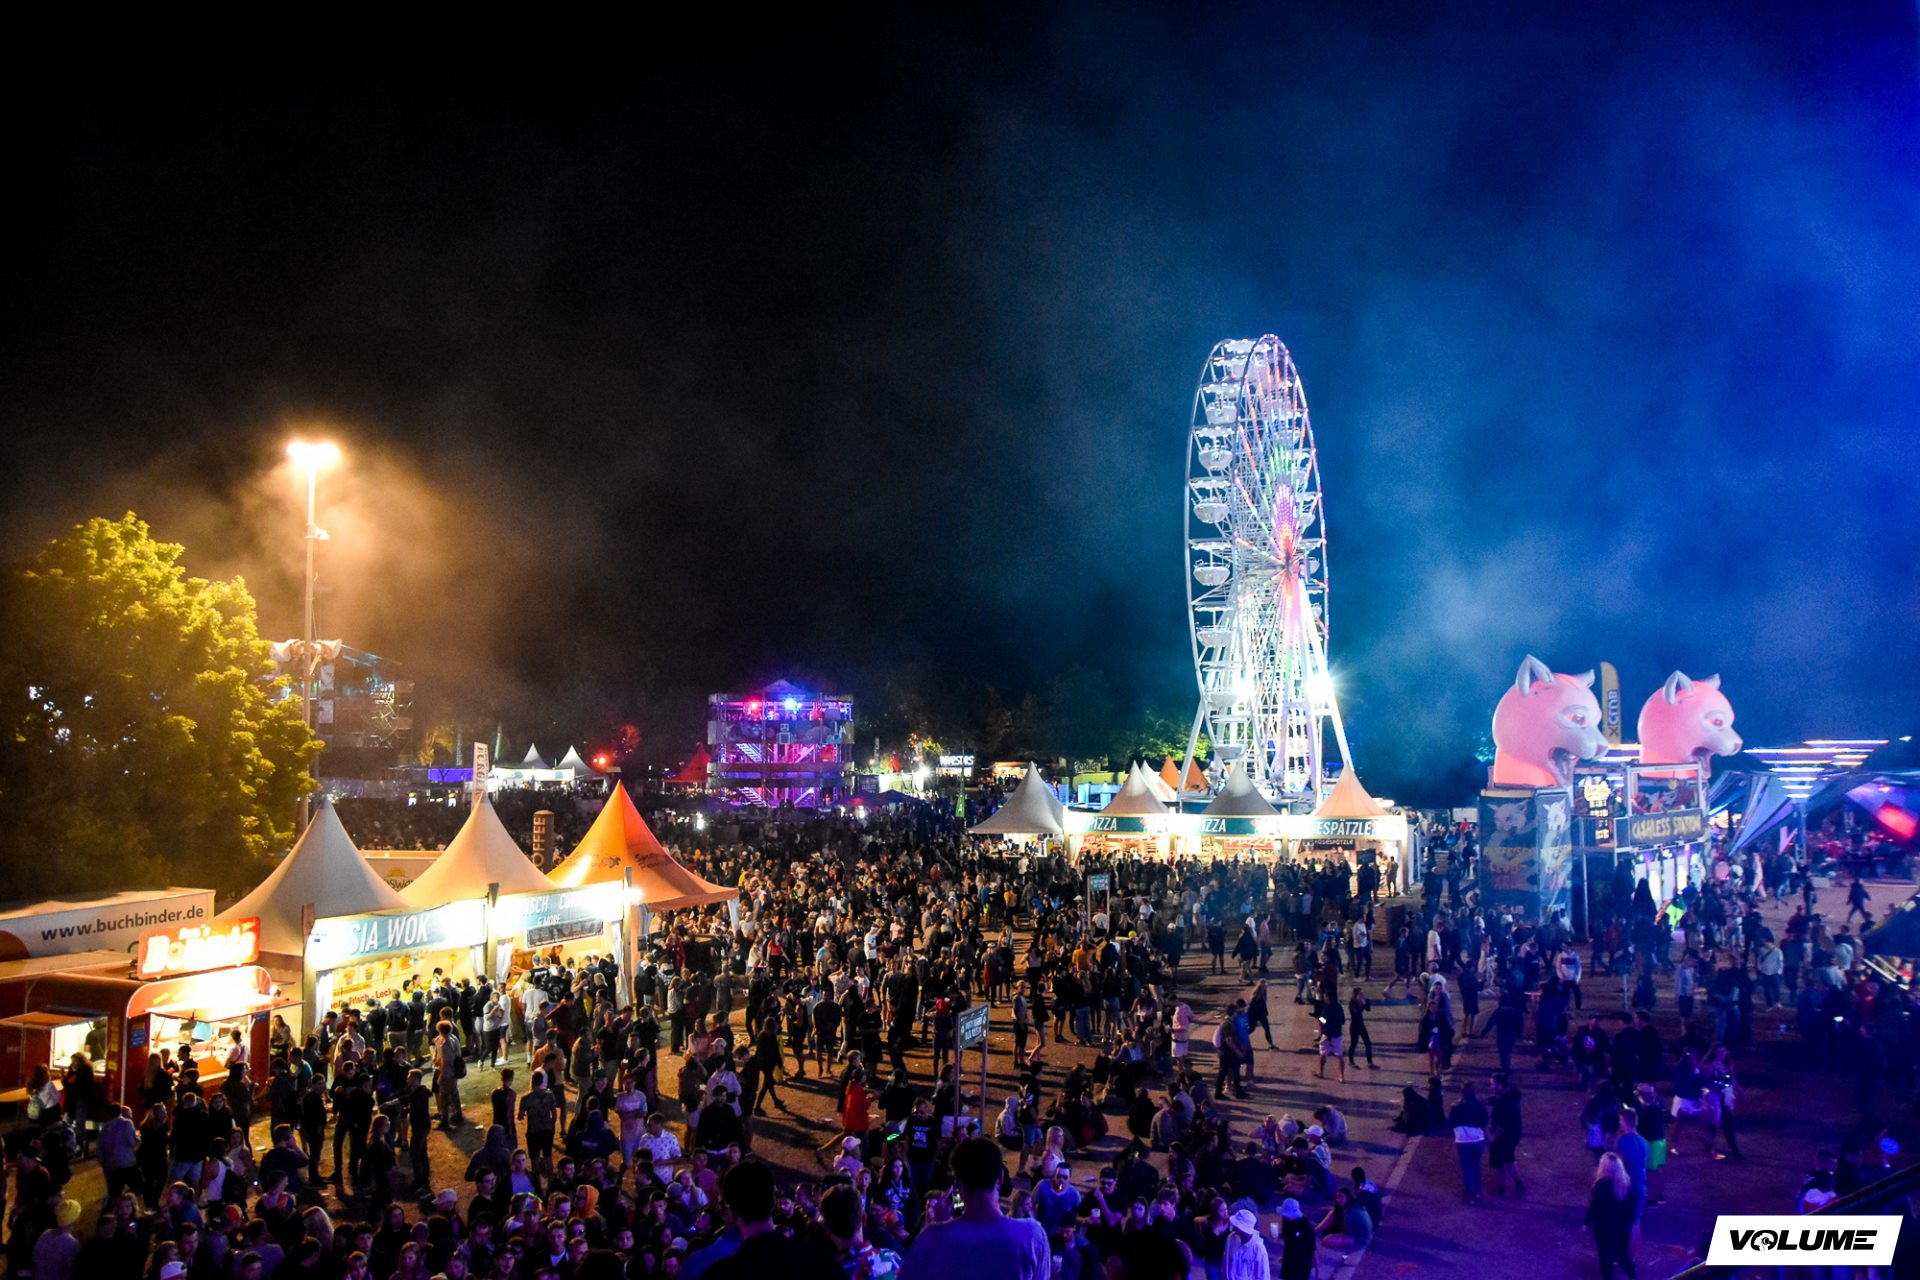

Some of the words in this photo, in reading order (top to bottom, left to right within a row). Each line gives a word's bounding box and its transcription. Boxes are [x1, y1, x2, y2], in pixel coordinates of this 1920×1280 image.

[1088, 817, 1117, 831] PIZZA
[531, 817, 545, 867] OFFEE
[41, 905, 204, 940] www.buchbinder.de
[387, 914, 431, 947] WOK
